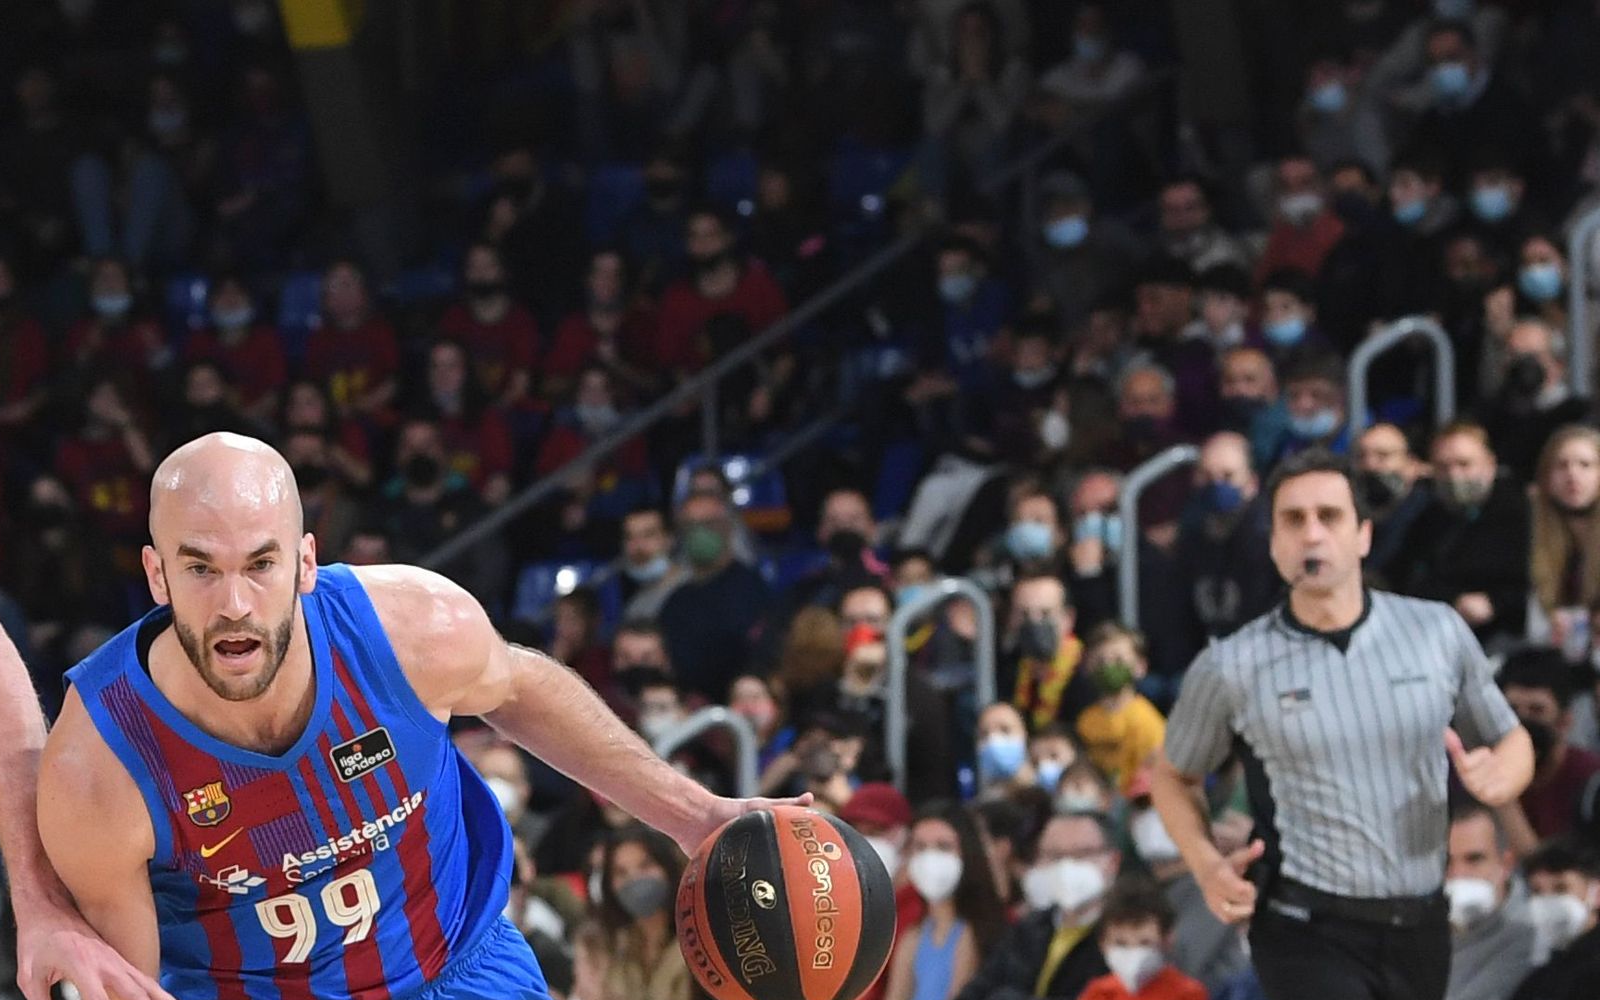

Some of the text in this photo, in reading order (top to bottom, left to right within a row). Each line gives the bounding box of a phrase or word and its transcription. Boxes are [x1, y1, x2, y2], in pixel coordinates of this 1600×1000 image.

[339, 751, 363, 768] liga
[344, 748, 392, 777] endesa
[281, 790, 424, 873] Assistència
[254, 867, 381, 964] 99
